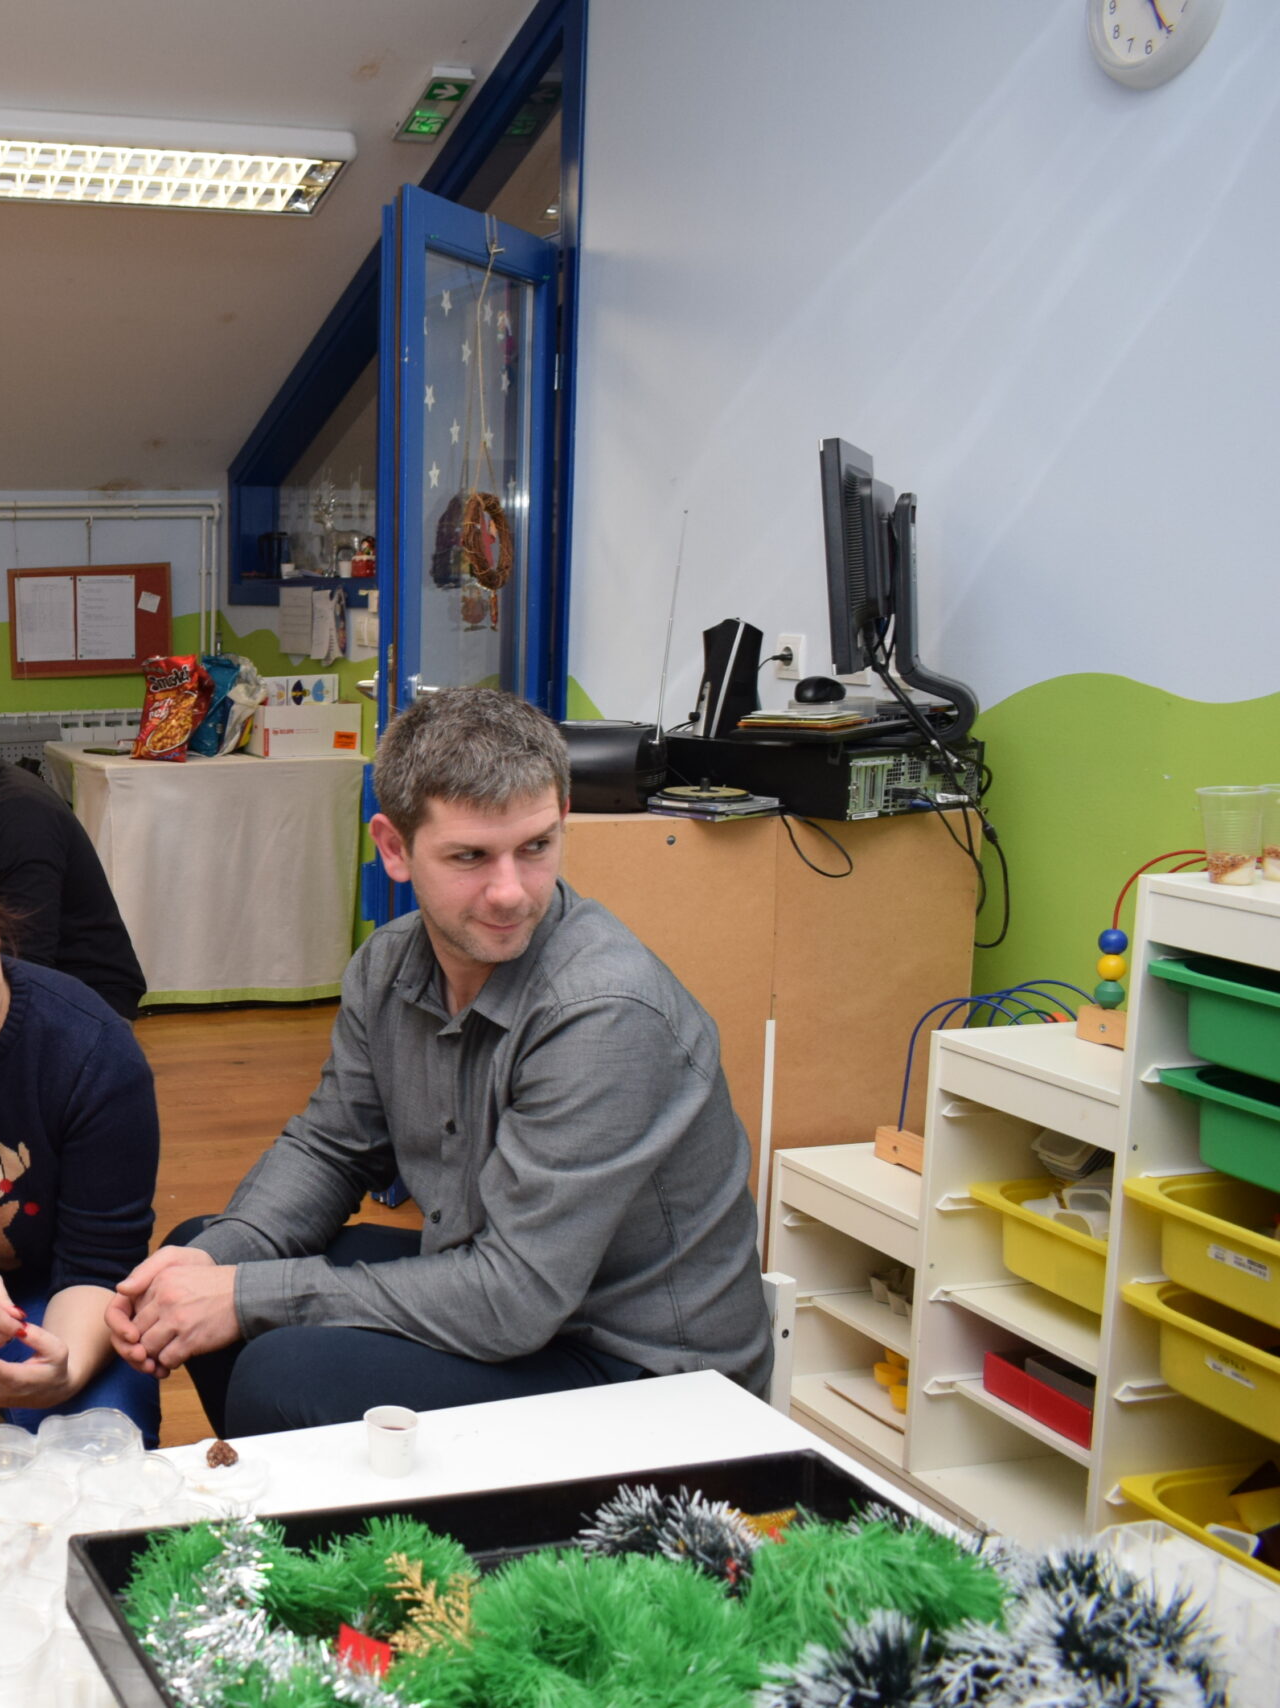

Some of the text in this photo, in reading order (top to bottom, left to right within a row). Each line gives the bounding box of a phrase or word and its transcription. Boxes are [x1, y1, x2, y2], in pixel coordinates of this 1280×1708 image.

[1109, 0, 1117, 15] 9
[1113, 24, 1121, 40] 8
[1126, 37, 1136, 53] 7
[1145, 39, 1153, 55] 6
